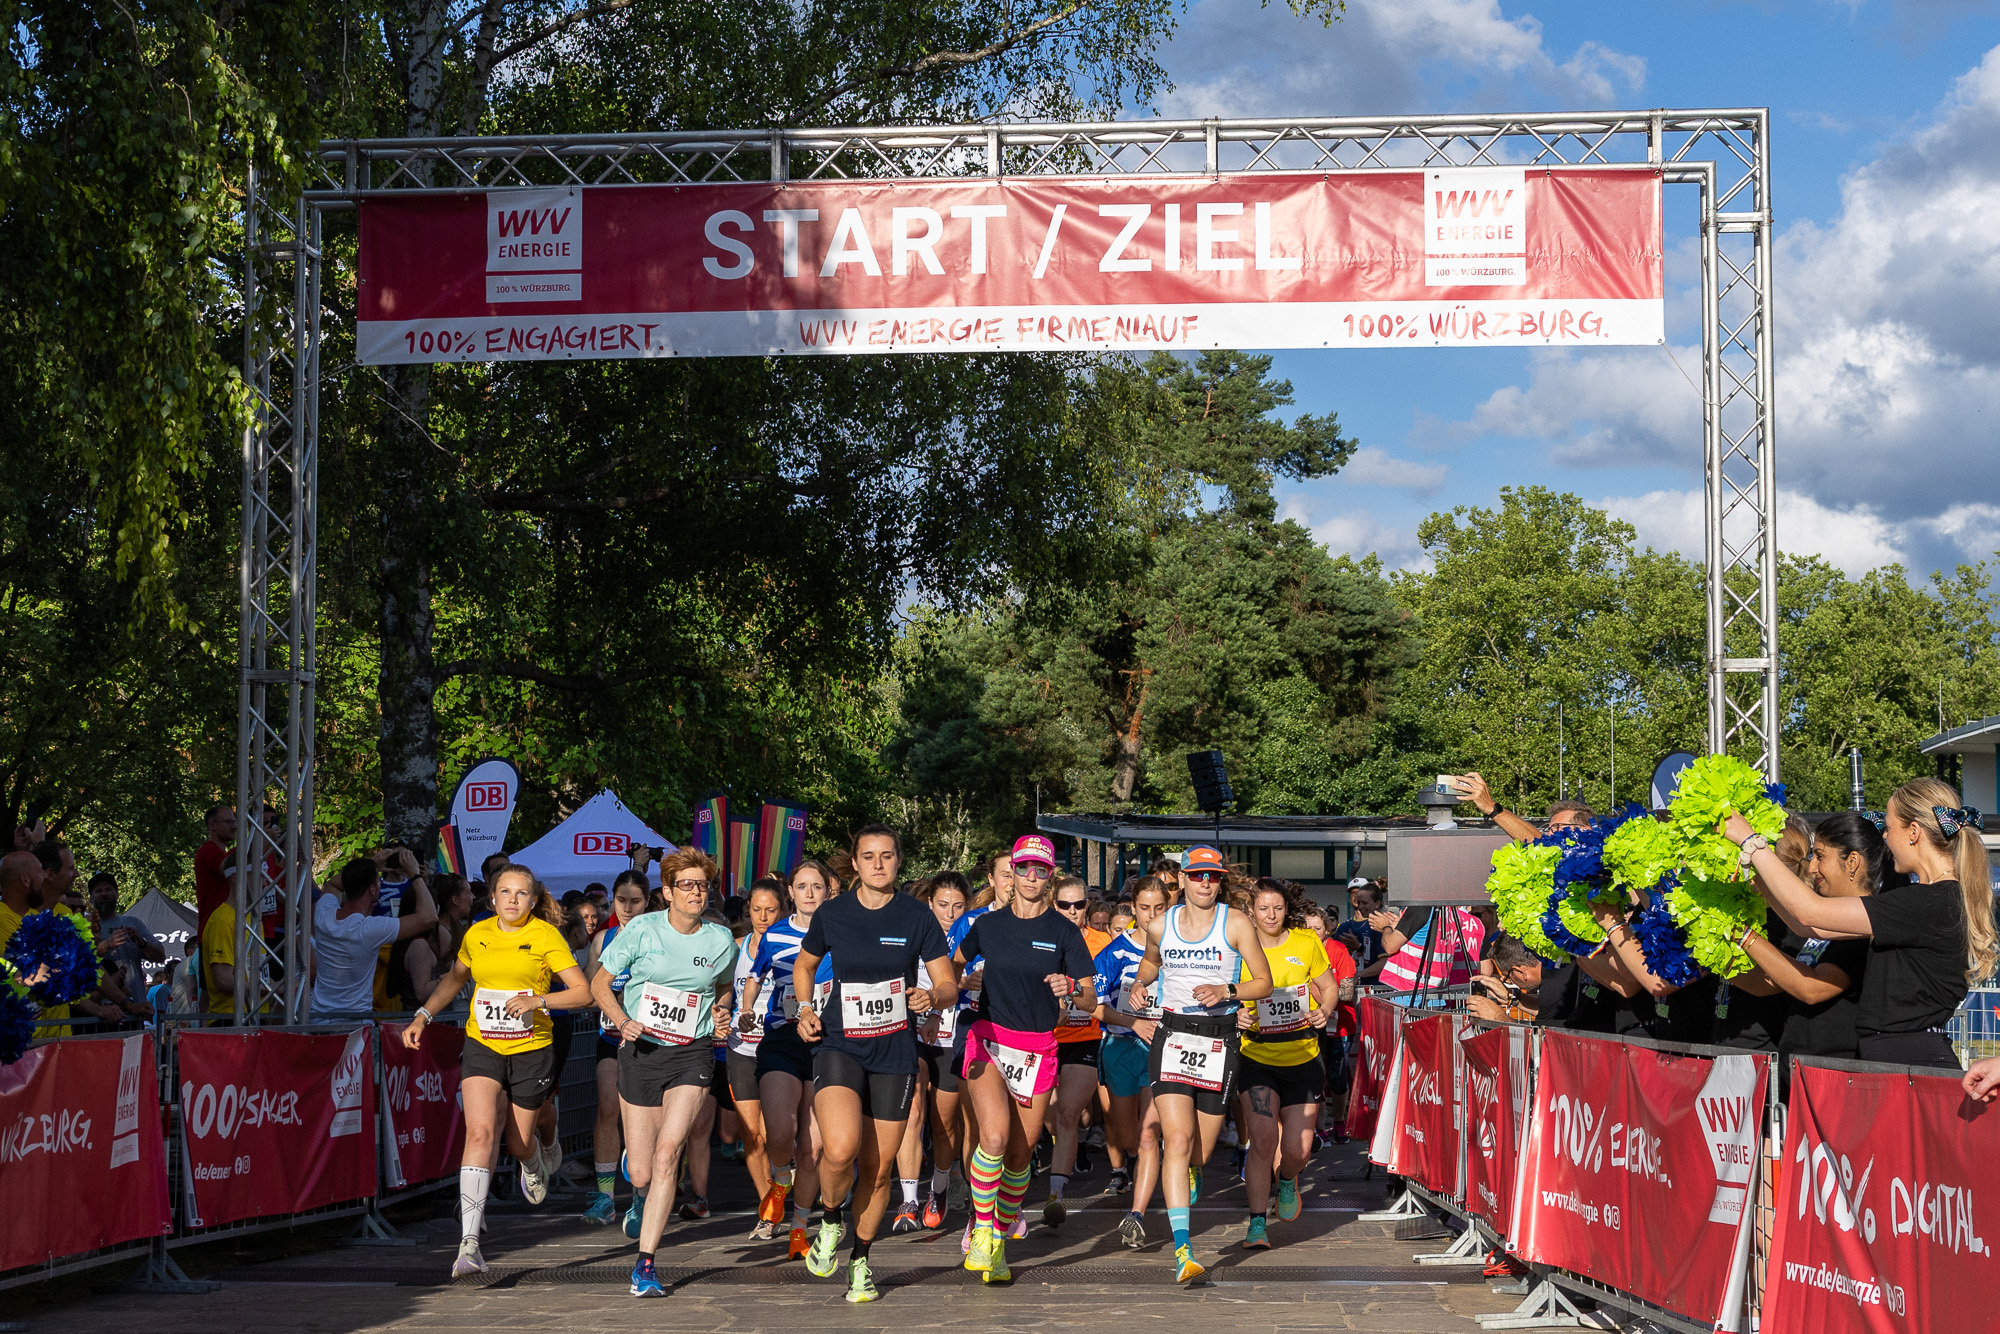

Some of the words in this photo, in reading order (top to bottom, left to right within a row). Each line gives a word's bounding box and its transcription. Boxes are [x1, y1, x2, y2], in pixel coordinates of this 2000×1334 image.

[1435, 189, 1514, 219] WVV
[497, 207, 572, 238] WVV
[702, 204, 1007, 281] START
[1032, 203, 1068, 280] /
[1098, 200, 1300, 273] ZIEL
[1437, 225, 1513, 241] ENERGIE
[498, 242, 571, 258] ENERGIE
[1460, 267, 1516, 276] WÜRZBURG.
[520, 283, 573, 293] WÜRZBURG.
[800, 319, 858, 346] WVV
[867, 316, 1006, 346] ENERGIE
[1016, 313, 1199, 344] FIRMENLAUF
[1343, 312, 1420, 340] 100%
[1427, 305, 1610, 340] WÜRZBURG.
[404, 330, 476, 355] 100%
[484, 323, 664, 354] ENGAGIERT.
[471, 786, 503, 807] DB
[788, 817, 803, 829] DB
[465, 834, 498, 842] Würzburg
[580, 836, 625, 852] DB
[1027, 842, 1052, 855] MUCH
[1164, 945, 1222, 962] rexroth
[1189, 962, 1222, 972] Company
[649, 1001, 687, 1024] 3340
[855, 997, 894, 1016] 1499
[1268, 1000, 1301, 1016] 3298
[1179, 1050, 1207, 1069] 282
[1890, 1176, 1991, 1258] DIGITAL.
